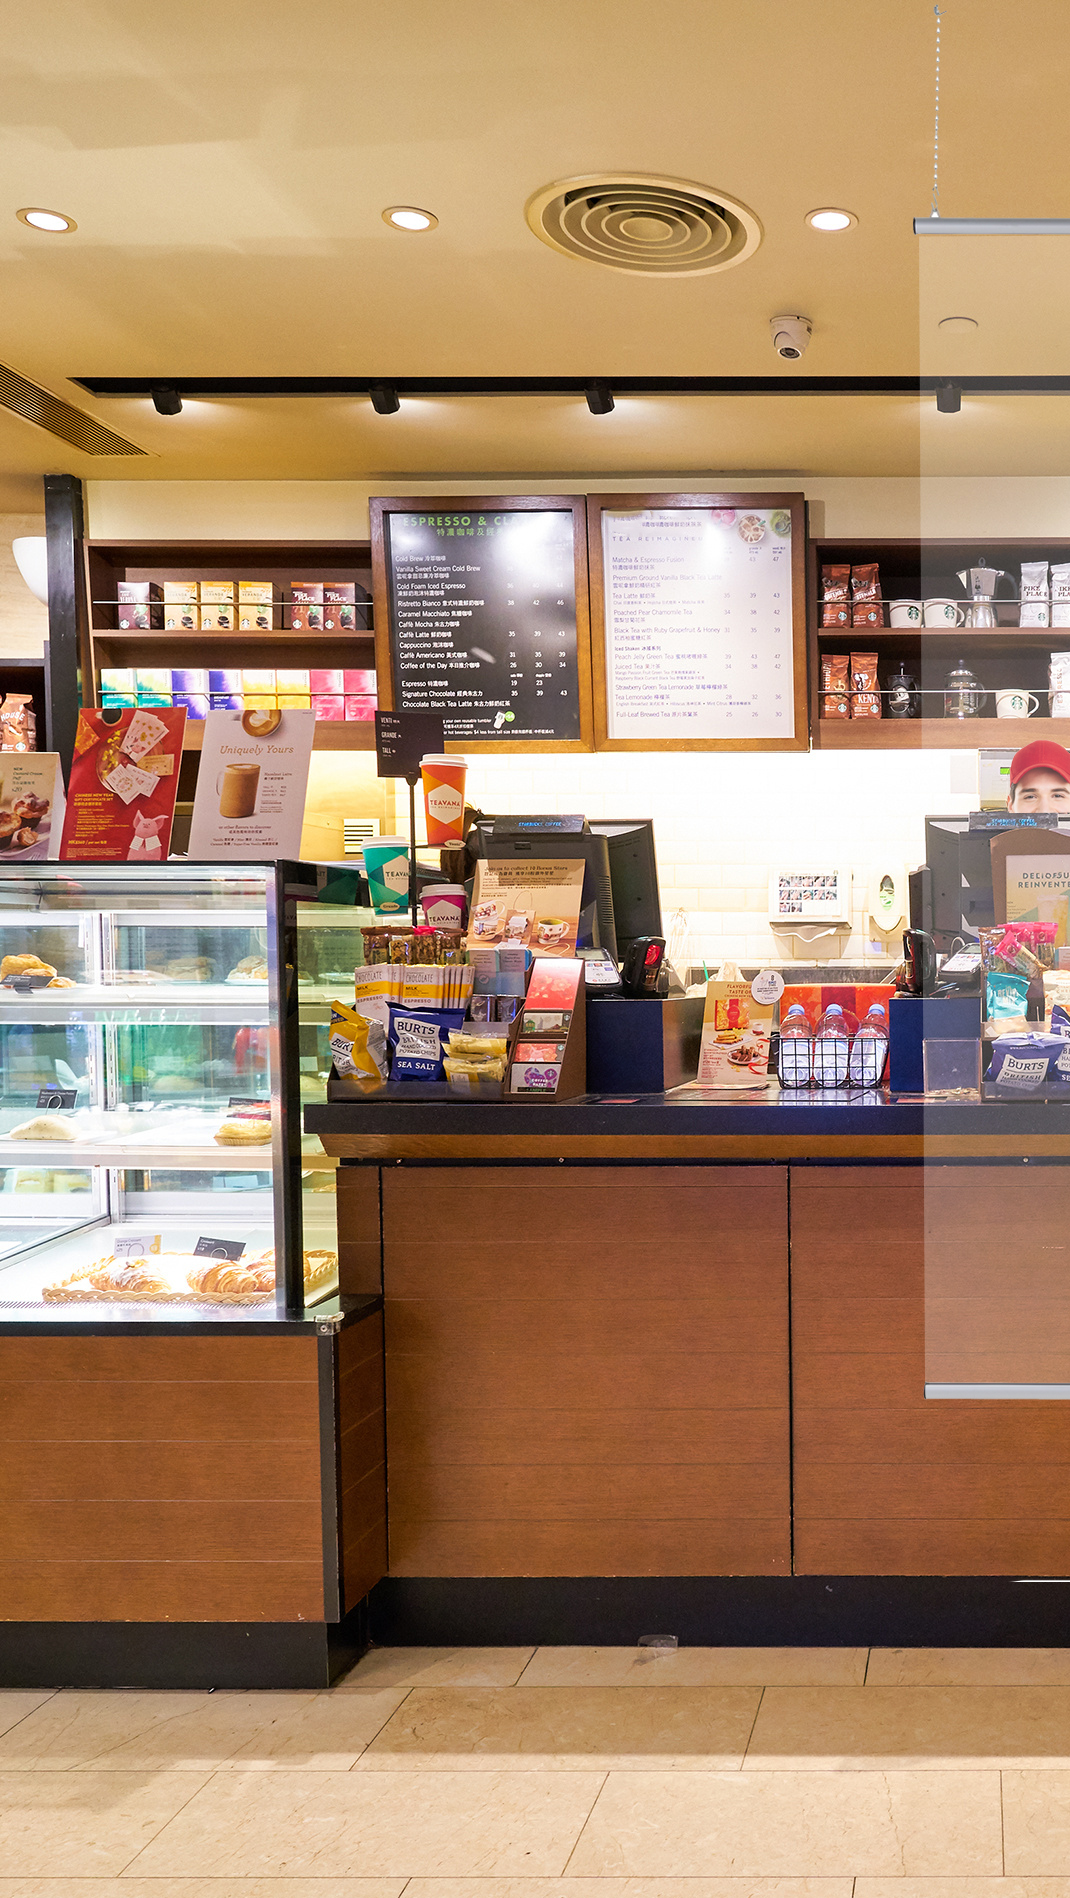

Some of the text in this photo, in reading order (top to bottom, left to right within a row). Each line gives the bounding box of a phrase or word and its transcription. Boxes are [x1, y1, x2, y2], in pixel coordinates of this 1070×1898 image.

[404, 517, 487, 526] ESPRESSO &
[0, 712, 25, 721] HOUSE
[220, 745, 294, 756] Uniquely Yours
[397, 1021, 435, 1035] BURTS
[415, 1062, 435, 1070] SALT
[1007, 1059, 1044, 1070] BURTS
